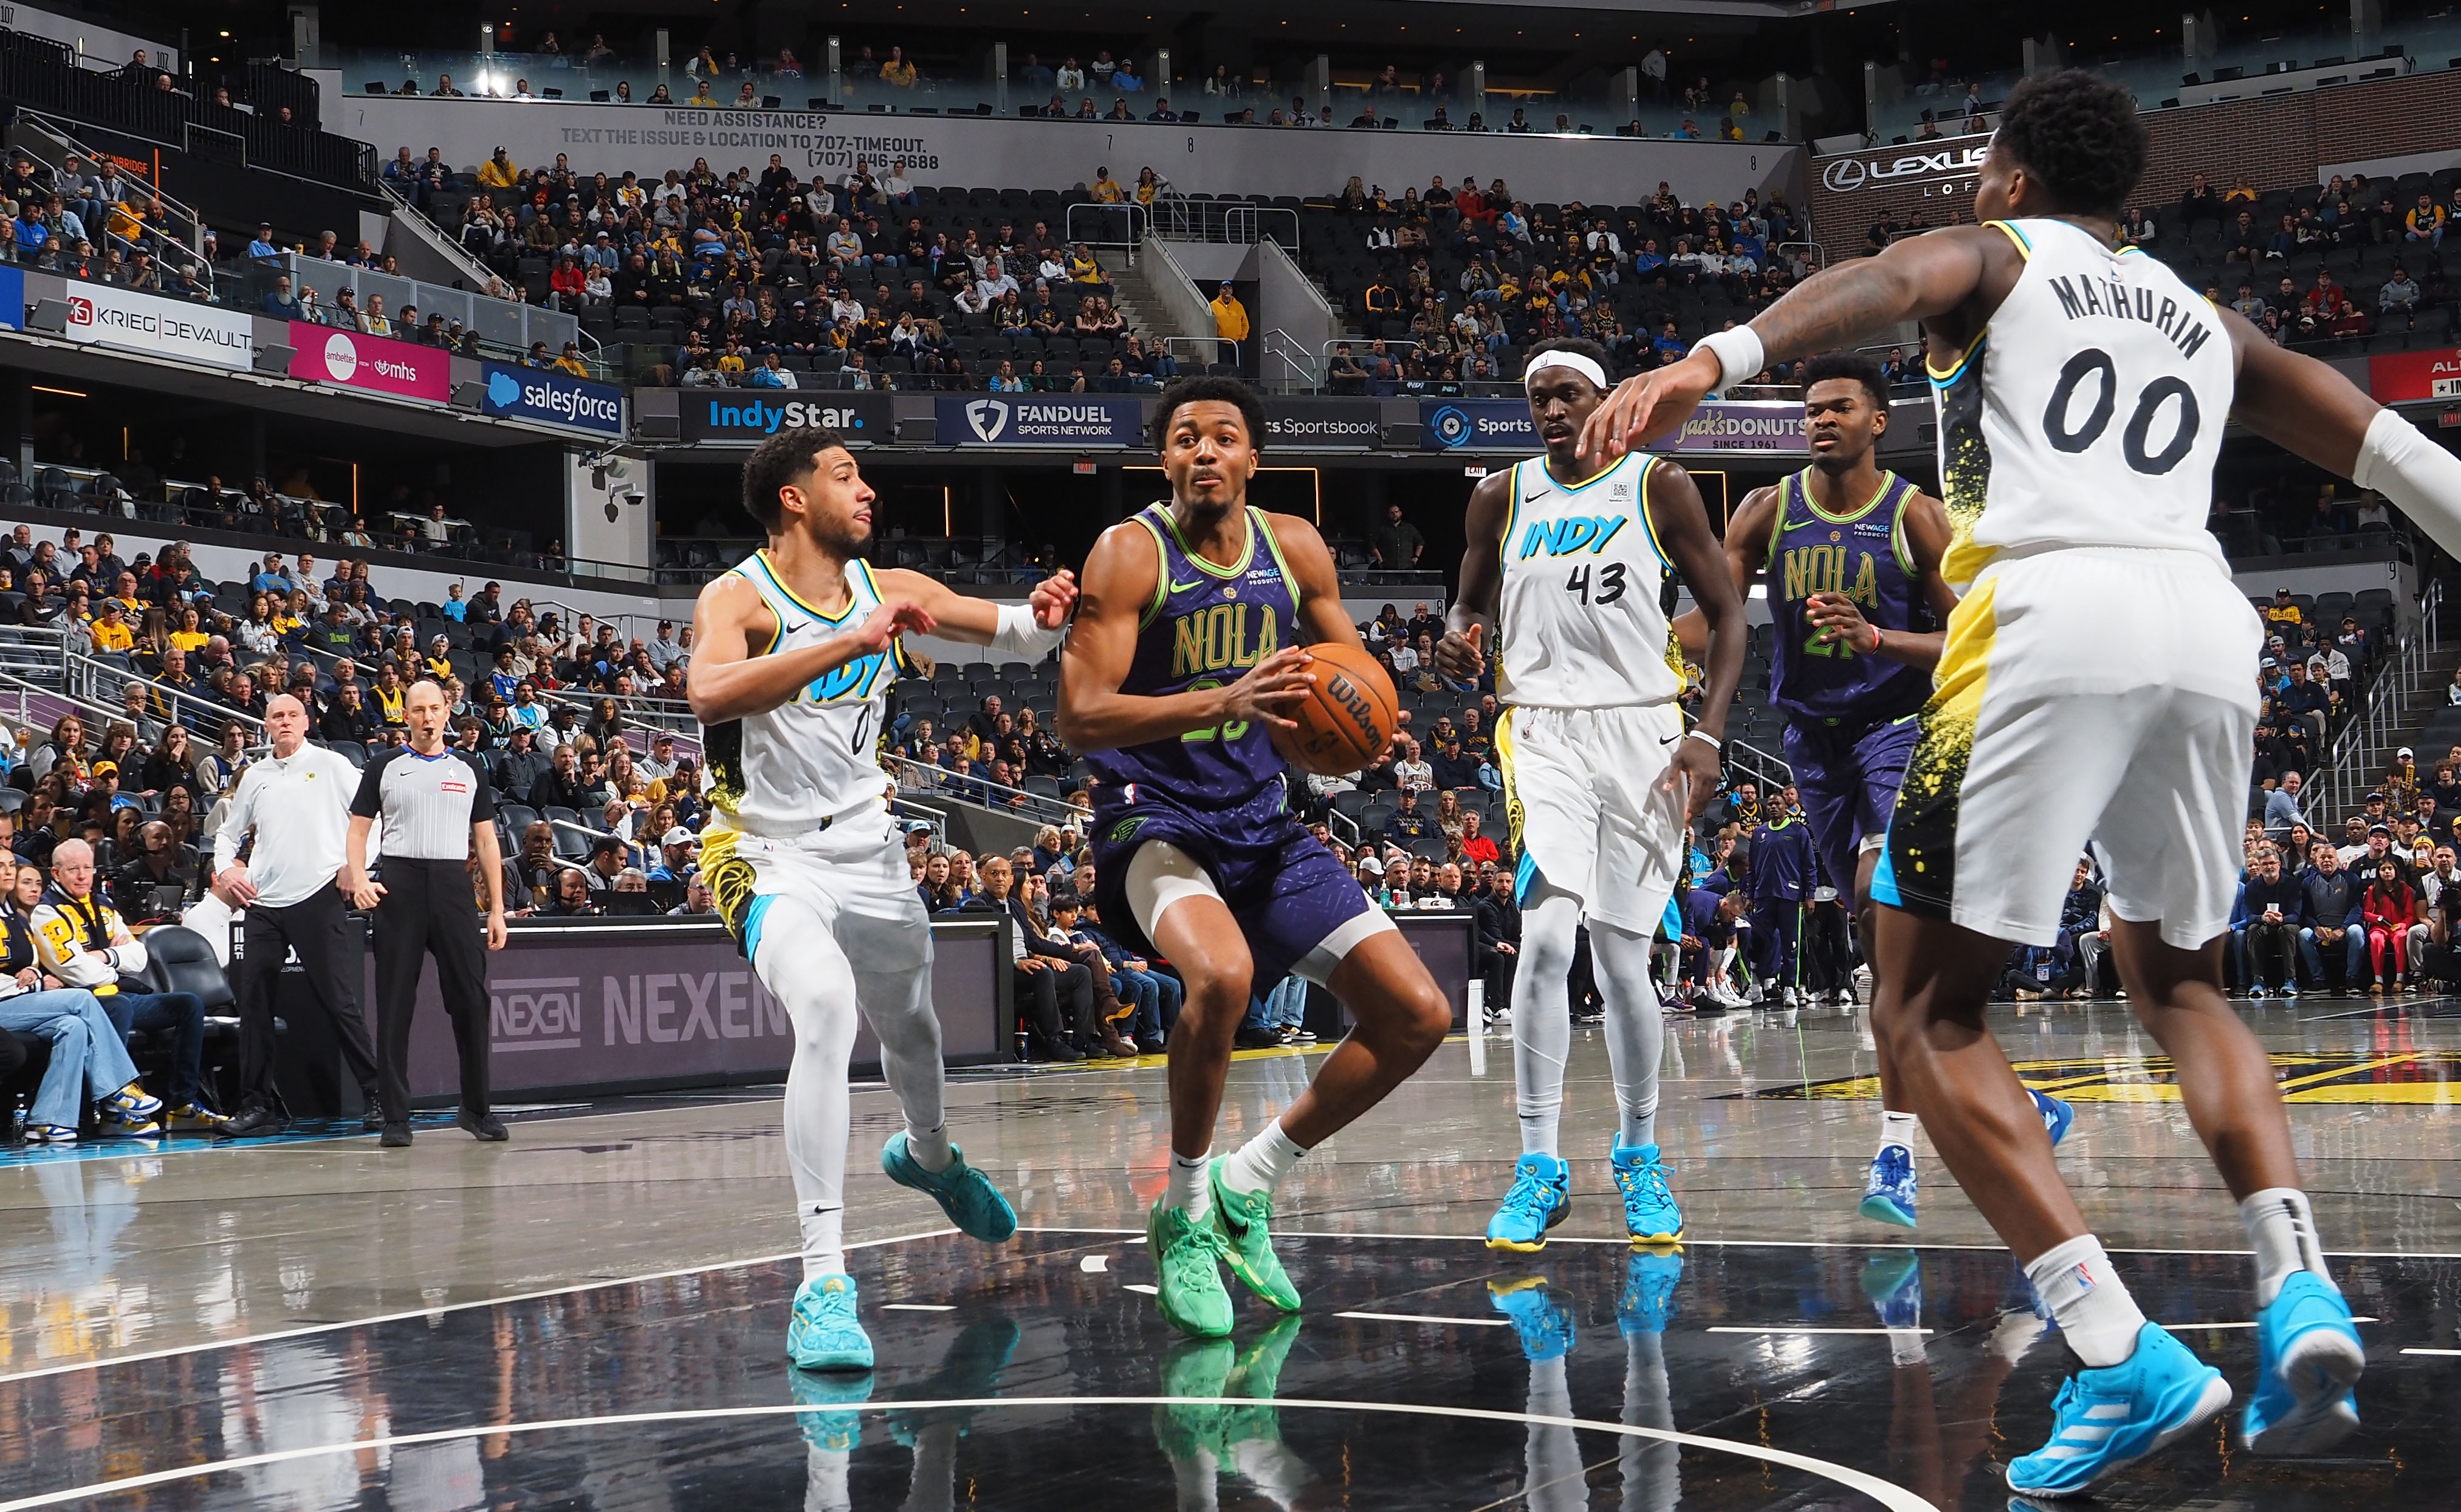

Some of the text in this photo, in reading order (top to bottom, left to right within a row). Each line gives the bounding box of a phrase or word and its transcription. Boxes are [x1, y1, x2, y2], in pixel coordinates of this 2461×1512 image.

[1, 5, 14, 24] 107
[157, 50, 169, 69] 107
[359, 110, 364, 126] 7
[664, 111, 827, 129] NEED ASSISTANCE?
[561, 128, 927, 152] TEXT THE ISSUE & LOCATION TO 707-TIMEOUT.
[1107, 135, 1113, 151] 7
[1188, 137, 1194, 153] 8
[808, 150, 853, 168] (707)
[1924, 182, 1972, 197] LOF
[2047, 273, 2212, 361] MATHURIN
[97, 307, 252, 349] KRIEG DEVAULT
[524, 382, 617, 422] salesforce
[2042, 347, 2201, 476] 00
[710, 400, 863, 434] IndyStar.
[1017, 406, 1112, 423] FANDUEL
[1018, 426, 1112, 436] SPORTS NETWORK
[1283, 418, 1378, 437] Sportsbook
[1478, 418, 1532, 436] Sports
[1712, 440, 1777, 450] SINCE 1961
[1854, 523, 1889, 532] NEWAGE
[1519, 515, 1629, 562] INDY
[1246, 567, 1280, 579] NEWAGE
[1784, 545, 1878, 609] NOLA
[2389, 561, 2396, 580] 9
[1249, 577, 1282, 586] PRODUCTS
[1566, 562, 1627, 606] 43
[1437, 600, 1443, 617] 8
[1171, 603, 1277, 677] NOLA
[1327, 672, 1382, 750] Wilson
[851, 703, 871, 756] 0
[491, 991, 581, 1036] NEXEN
[603, 972, 792, 1046] NEXEN
